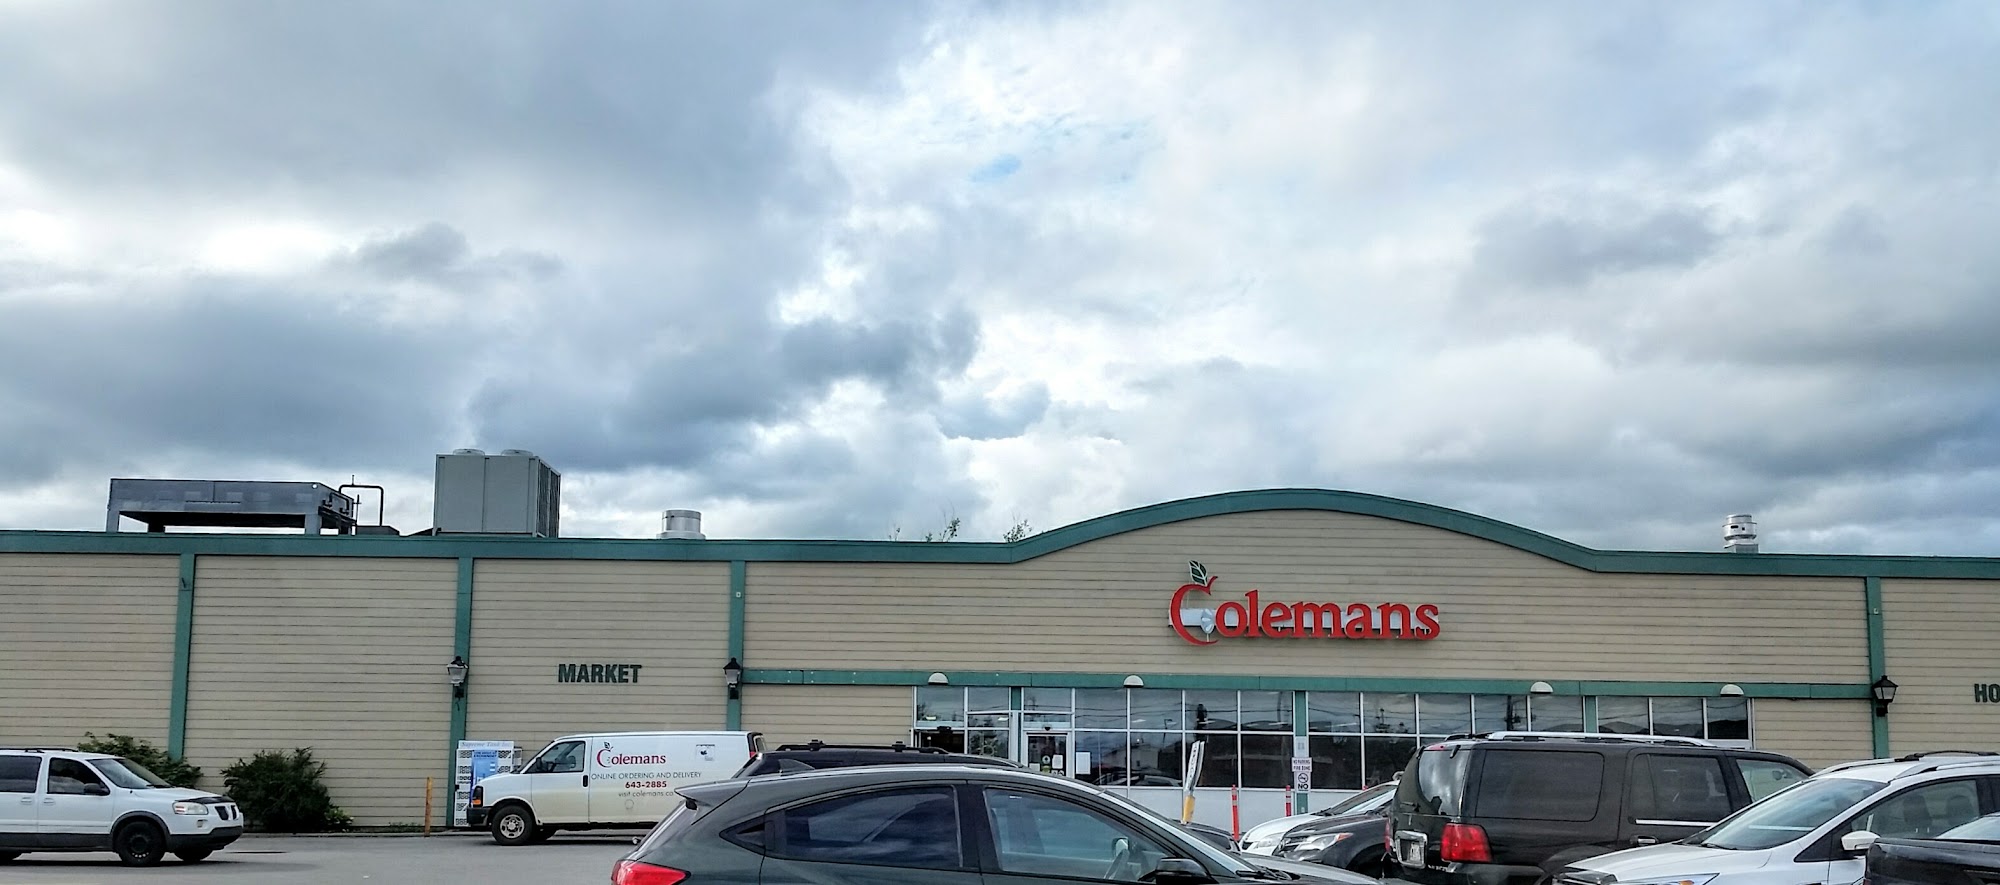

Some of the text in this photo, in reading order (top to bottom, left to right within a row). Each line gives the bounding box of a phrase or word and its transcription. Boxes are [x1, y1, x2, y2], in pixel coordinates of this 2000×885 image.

[1169, 574, 1441, 646] Colemans
[558, 663, 643, 683] MARKET
[1974, 683, 2000, 703] HO
[596, 746, 667, 768] Colemans
[618, 772, 655, 780] ORDERING
[673, 771, 702, 779] DELIVERY
[625, 781, 667, 789] 643-2885
